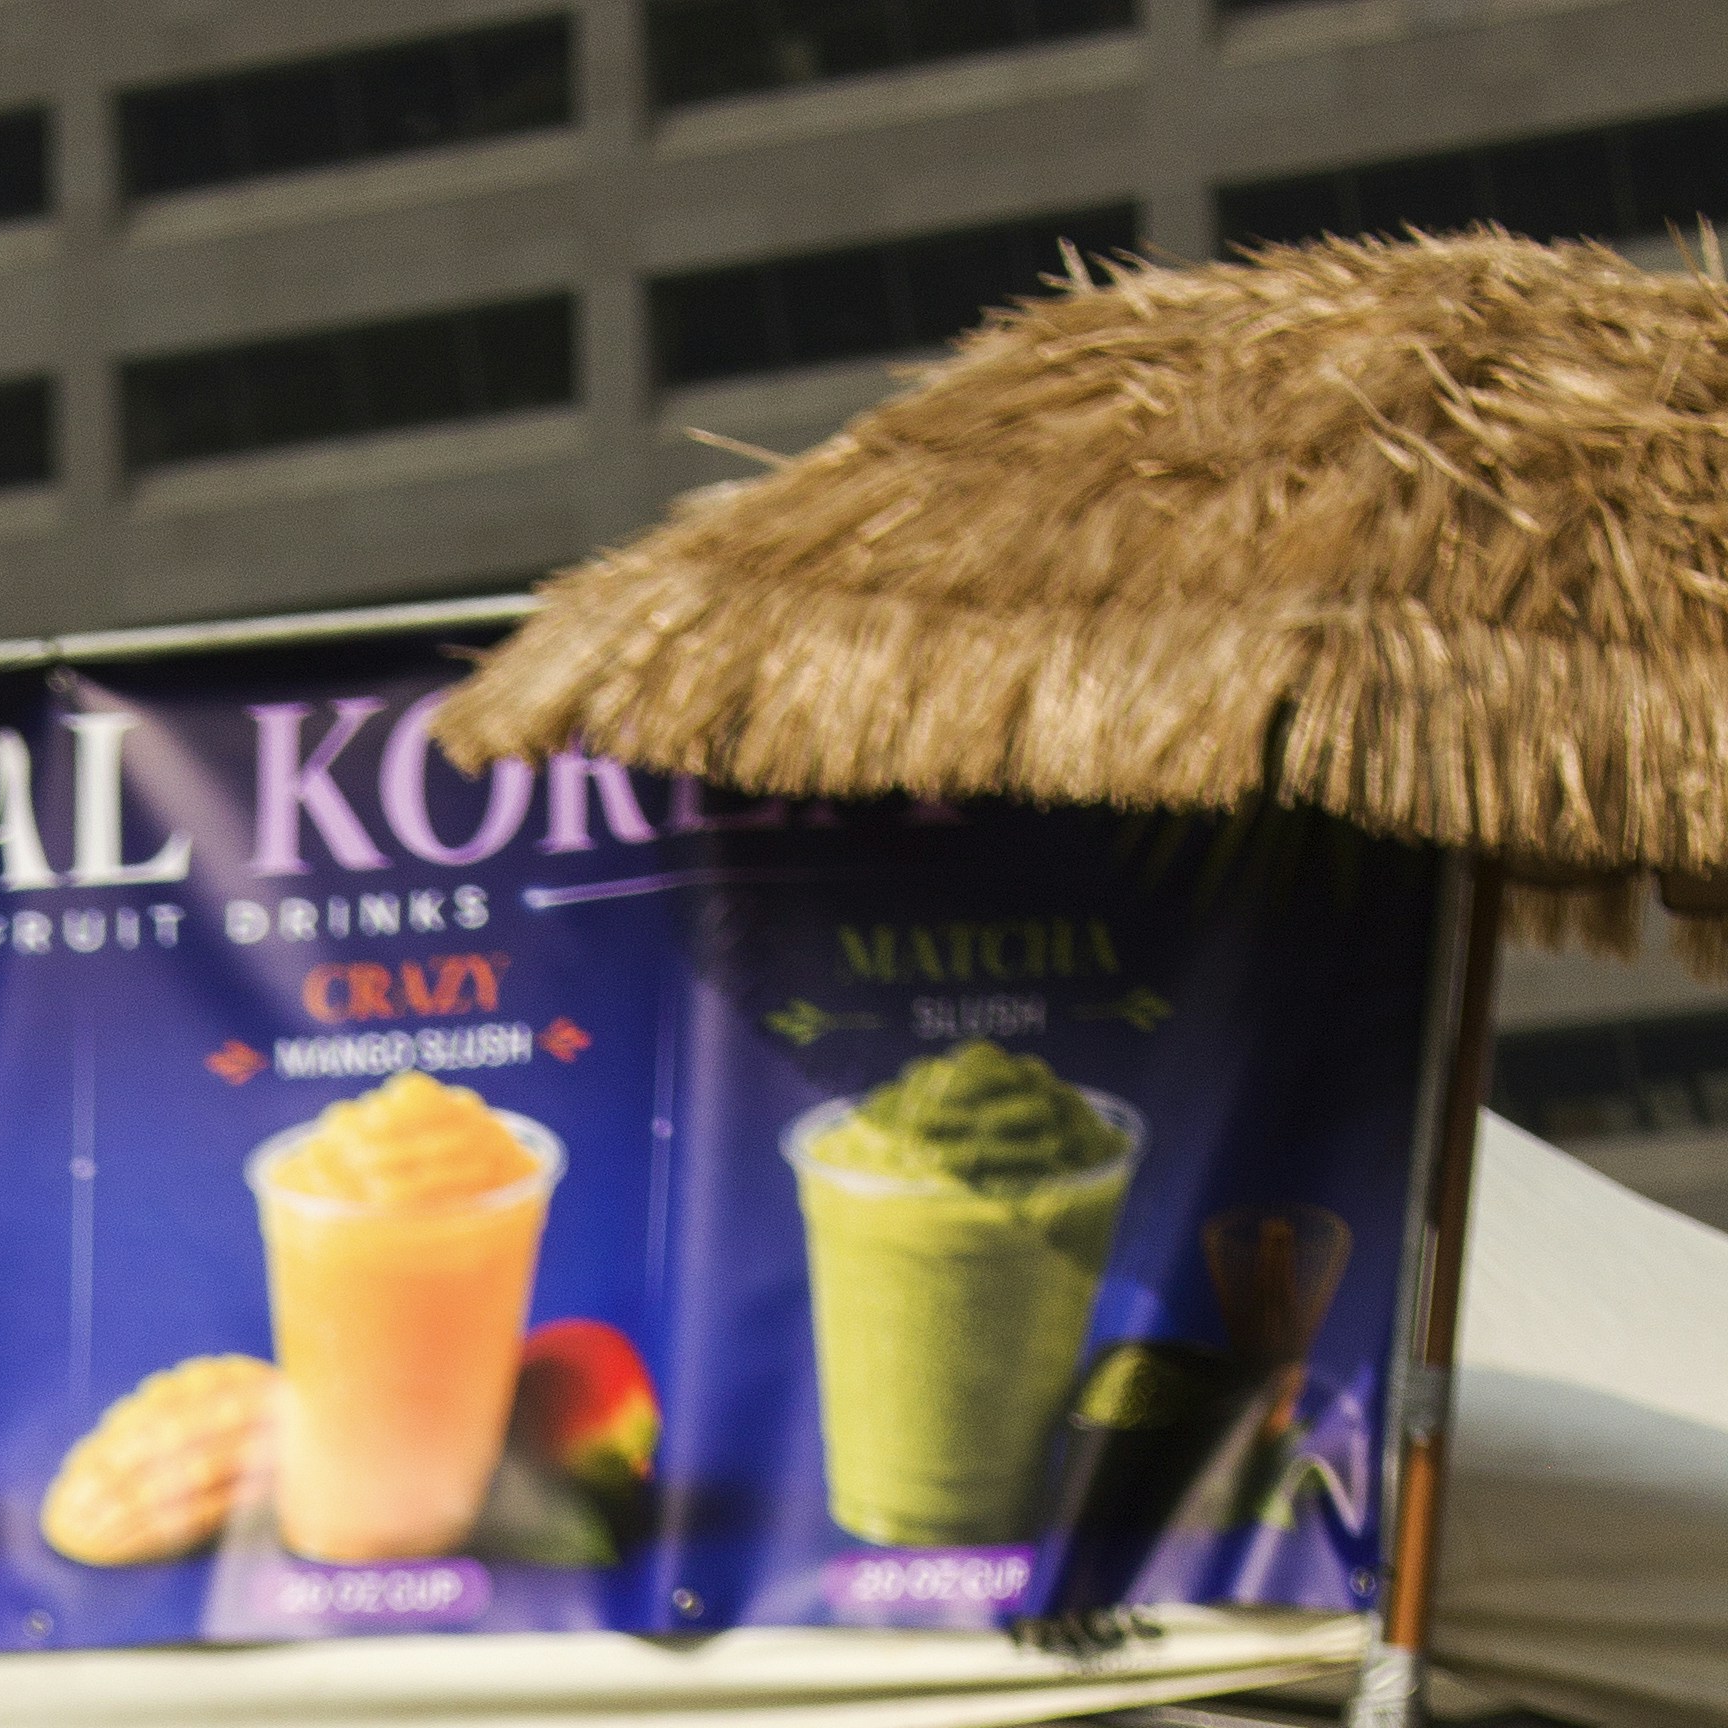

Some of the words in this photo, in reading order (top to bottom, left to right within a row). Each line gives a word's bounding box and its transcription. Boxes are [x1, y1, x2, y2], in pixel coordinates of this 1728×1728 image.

[224, 885, 490, 945] DRINKS
[834, 918, 1120, 984] MATCHA
[300, 950, 510, 1024] CRAZY
[912, 995, 1047, 1040] SLUSH
[274, 1030, 415, 1079] MANGO
[416, 1021, 533, 1072] SLUSH
